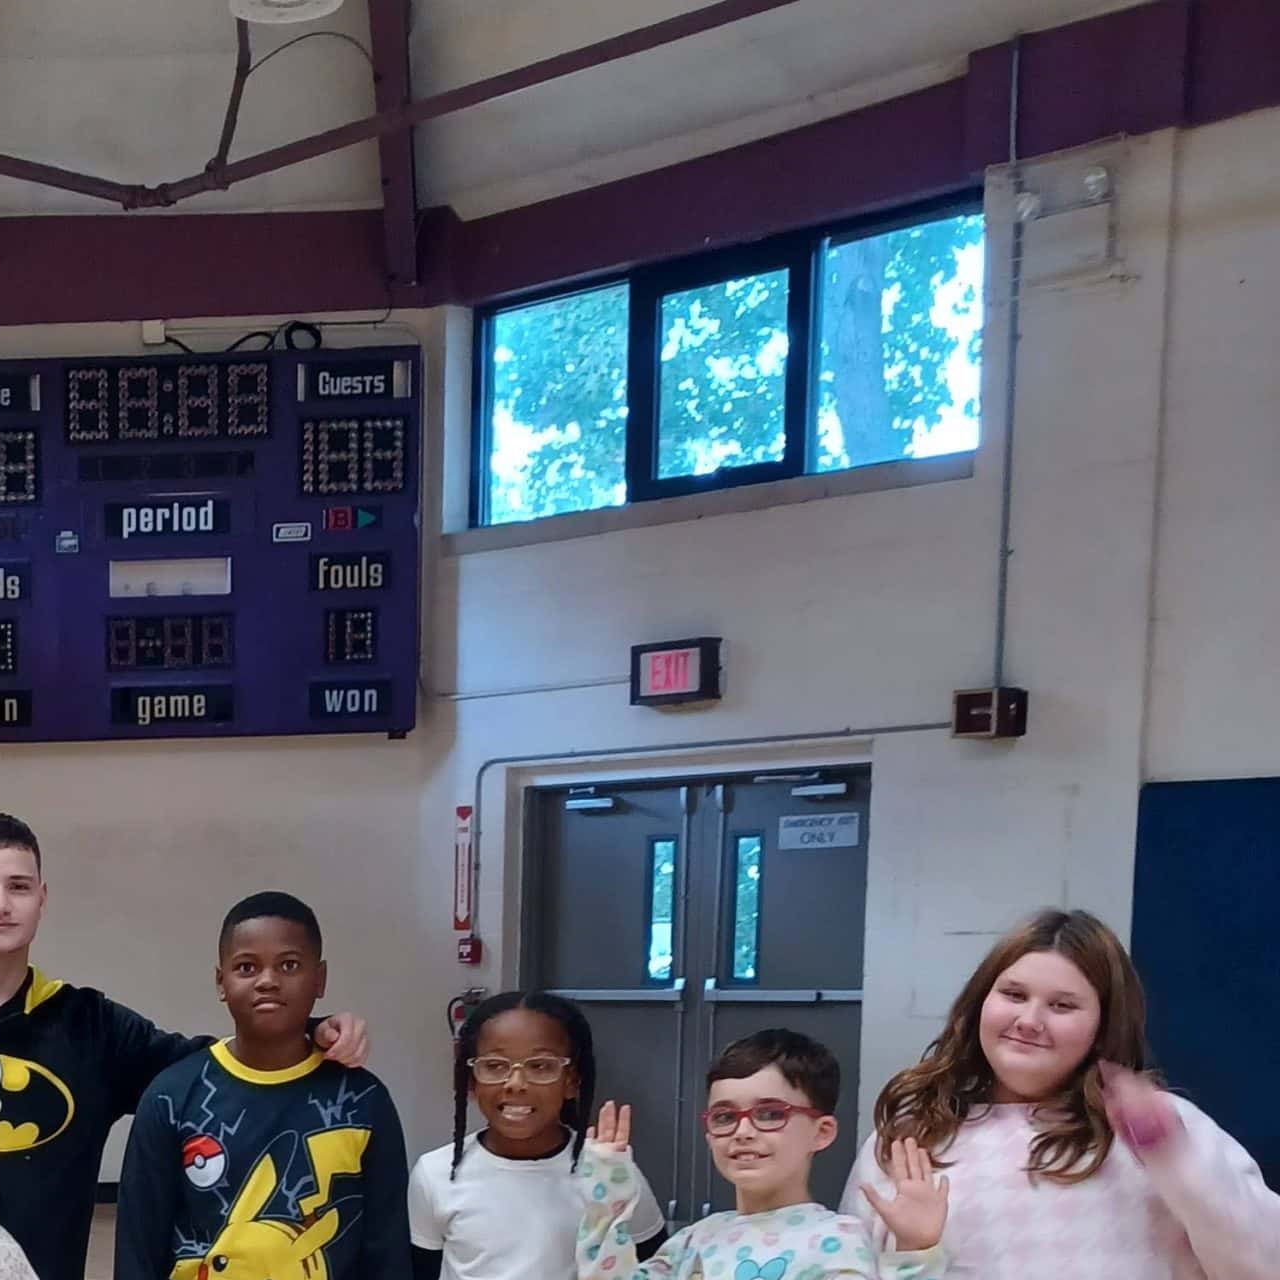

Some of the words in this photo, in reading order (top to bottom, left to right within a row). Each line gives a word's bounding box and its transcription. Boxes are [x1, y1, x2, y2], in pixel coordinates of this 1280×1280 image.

[319, 371, 385, 395] Guests
[122, 500, 214, 539] period
[318, 556, 384, 589] fouls
[651, 651, 689, 692] EXIT
[137, 694, 206, 724] game
[324, 689, 378, 712] won
